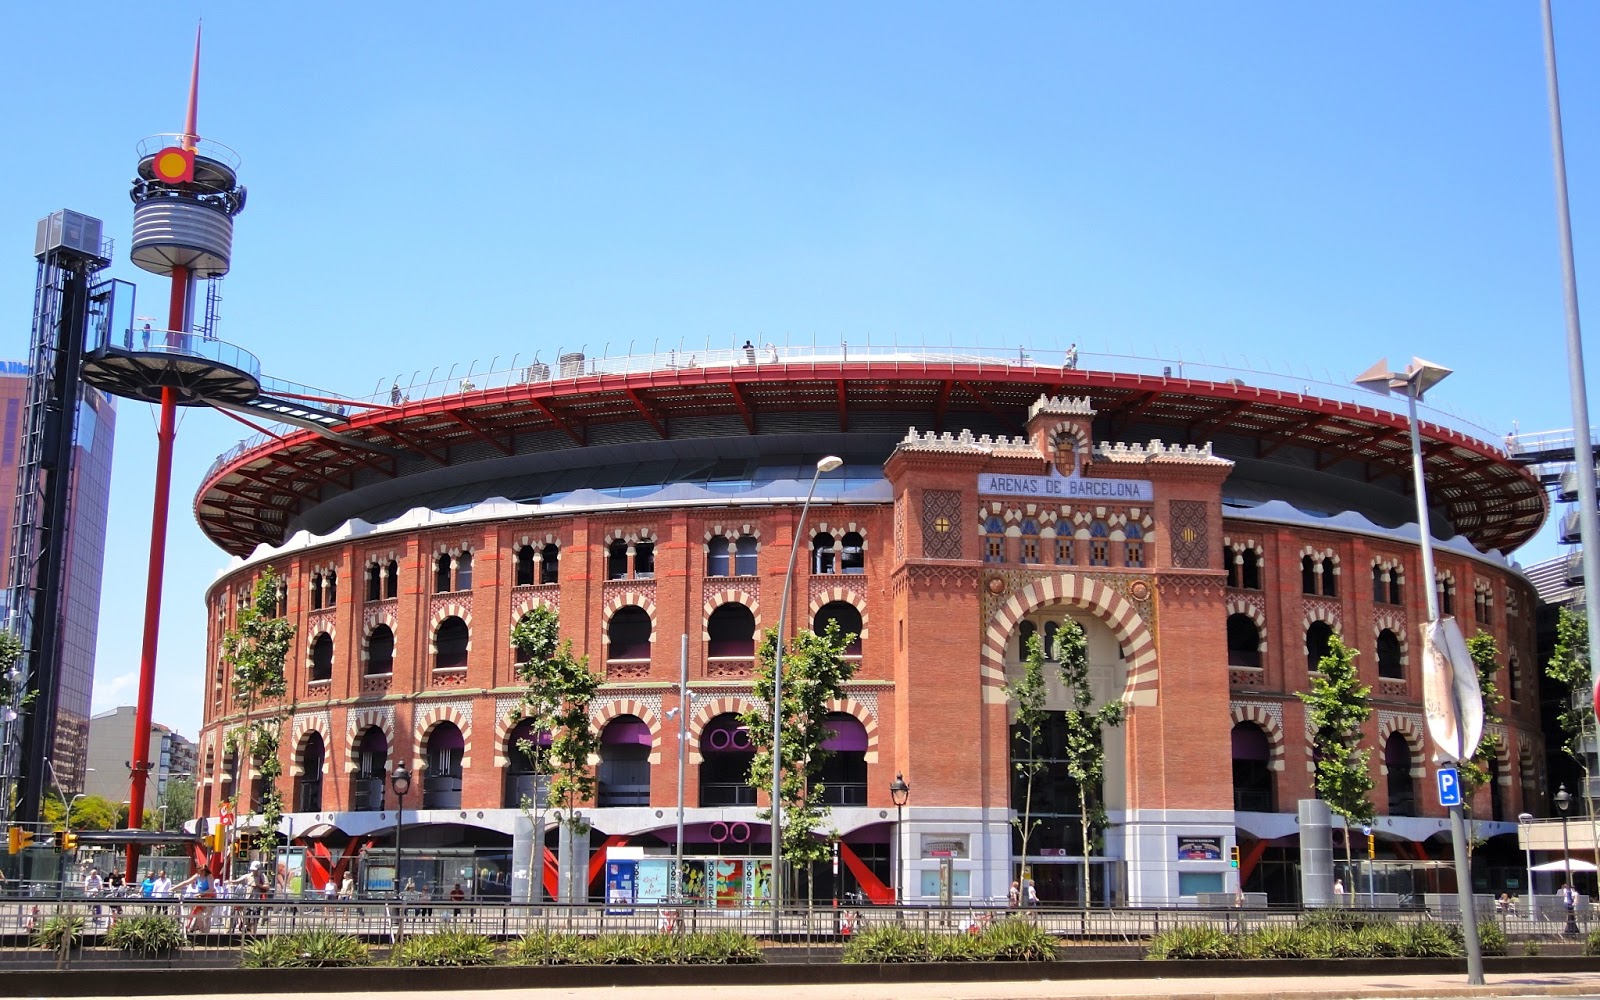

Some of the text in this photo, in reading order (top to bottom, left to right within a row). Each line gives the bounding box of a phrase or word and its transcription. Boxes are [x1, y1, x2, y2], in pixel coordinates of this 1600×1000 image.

[990, 477, 1141, 497] ARENAS DE BARCELONA
[1441, 774, 1454, 792] P
